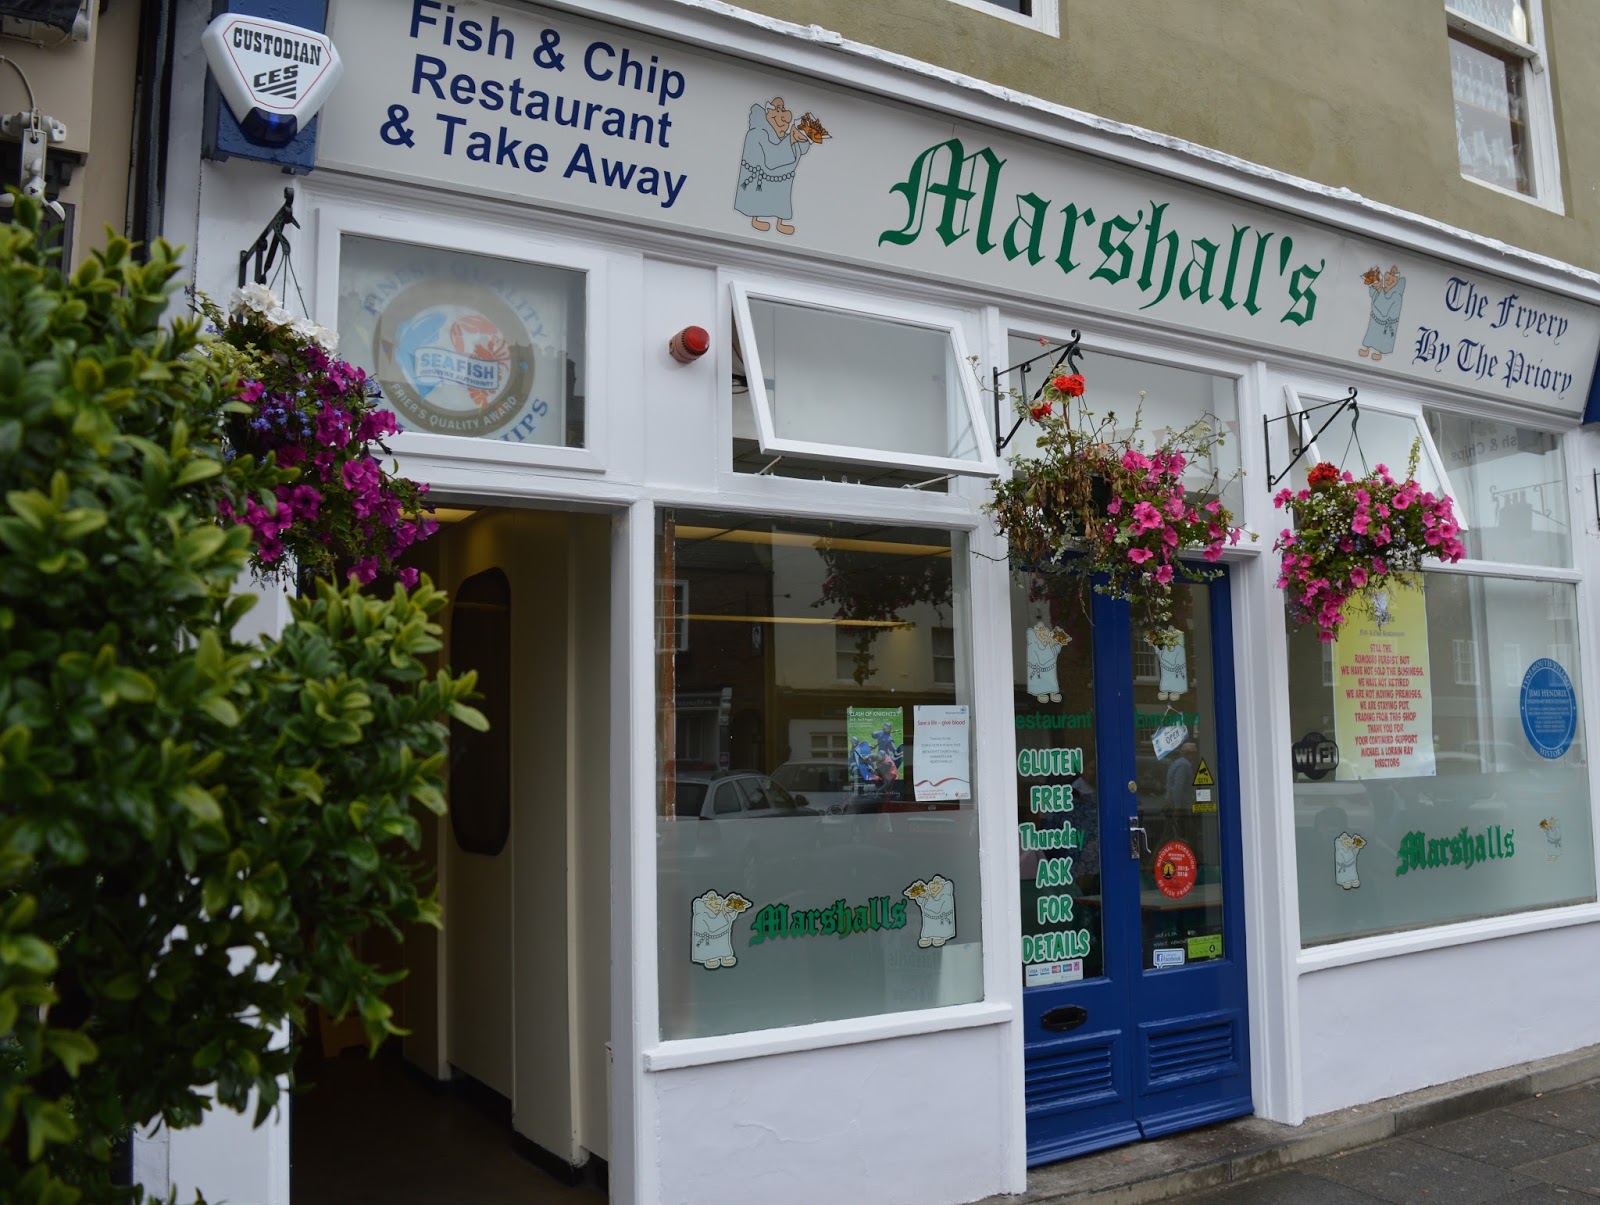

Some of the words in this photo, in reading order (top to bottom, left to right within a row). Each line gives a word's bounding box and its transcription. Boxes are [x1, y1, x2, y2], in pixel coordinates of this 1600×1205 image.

[233, 27, 321, 66] CUSTODIAN
[409, 0, 514, 59] Fish
[532, 29, 565, 72] &
[583, 41, 686, 105] Chip
[253, 64, 299, 87] CES
[411, 54, 672, 148] Restaurant
[379, 105, 414, 148] &
[437, 113, 549, 173] Take
[563, 143, 687, 208] Away
[878, 138, 1326, 326] Marshall's
[1445, 277, 1489, 321] The
[1490, 293, 1569, 345] Fryery
[420, 353, 495, 379] SEAFISH
[1412, 326, 1450, 373] By
[1457, 338, 1498, 381] The
[1501, 350, 1572, 400] Priory
[391, 384, 427, 420] FRIER'S
[430, 415, 480, 431] QUALITY
[484, 396, 518, 426] AWARD
[1341, 666, 1350, 676] WE
[1351, 666, 1363, 676] HAVE
[1364, 667, 1373, 676] NOT
[1386, 667, 1396, 676] THE
[1400, 656, 1410, 665] BUT
[1346, 690, 1354, 699] WE
[1355, 690, 1365, 699] ARE
[1366, 690, 1375, 698] NOT
[1358, 678, 1365, 687] WE
[1529, 689, 1541, 698] JIMI
[1541, 689, 1567, 697] HENDRIX
[1360, 701, 1367, 710] WE
[1368, 701, 1376, 710] ARE
[1377, 701, 1397, 710] STAYING
[1389, 713, 1402, 722] THIS
[1402, 712, 1417, 721] SHOP
[1354, 736, 1368, 745] YOUR
[1395, 735, 1418, 744] SUPPORT
[1367, 724, 1382, 734] THANK
[1383, 724, 1393, 733] YOU
[1394, 724, 1404, 733] FOR
[1018, 748, 1083, 777] GLUTEN
[1374, 758, 1400, 768] DIRECTORS
[1403, 746, 1414, 755] RAY
[1540, 747, 1564, 758] HISTORY
[1030, 785, 1073, 814] FREE
[1019, 821, 1085, 851] Thursday
[1396, 825, 1515, 878] Marshalls
[1036, 856, 1073, 889] ASK
[749, 895, 907, 947] Marshalls
[1038, 894, 1073, 925] FOR
[1022, 929, 1090, 964] DETAILS
